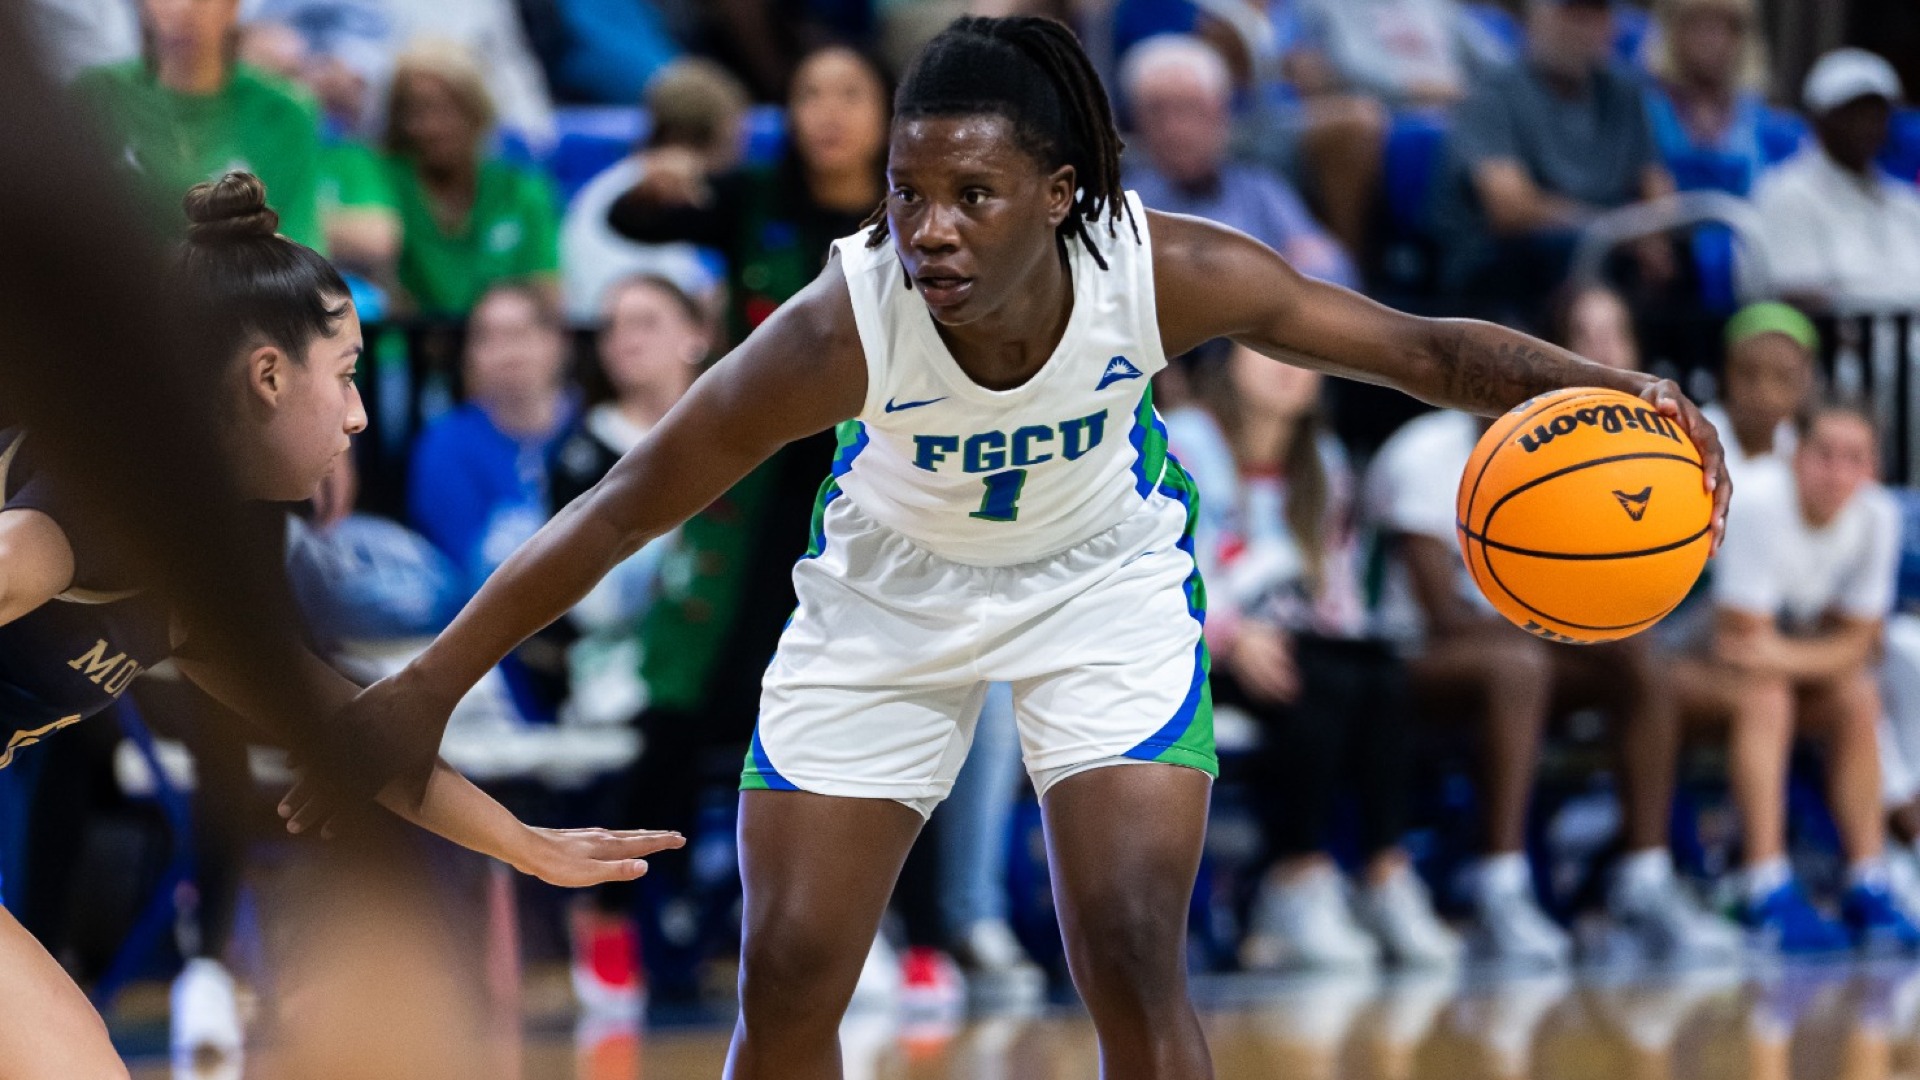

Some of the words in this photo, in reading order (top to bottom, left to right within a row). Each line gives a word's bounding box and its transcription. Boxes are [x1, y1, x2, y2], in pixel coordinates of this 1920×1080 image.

[912, 408, 1108, 473] FGCU
[1517, 404, 1682, 452] Wilson
[969, 469, 1027, 521] 1
[67, 638, 145, 699] MO
